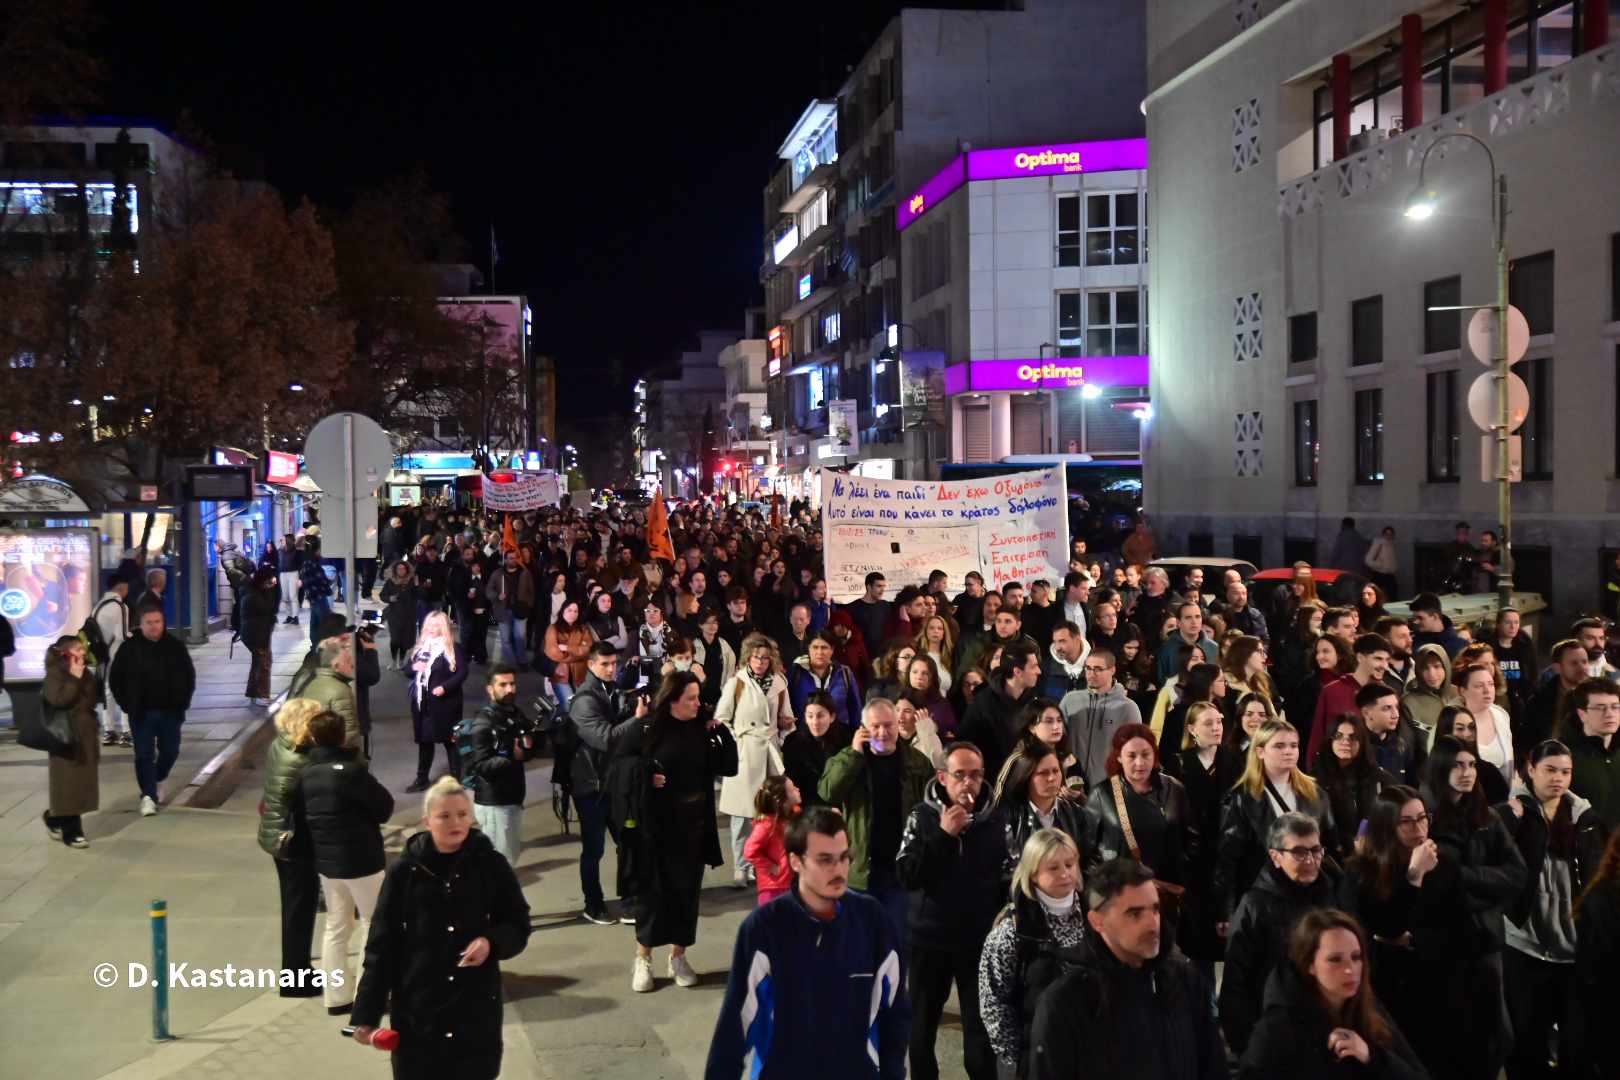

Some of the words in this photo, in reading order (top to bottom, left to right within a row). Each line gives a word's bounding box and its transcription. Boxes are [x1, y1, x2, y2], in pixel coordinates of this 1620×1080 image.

[1015, 150, 1080, 170] Optima
[1063, 162, 1082, 172] bank
[1017, 363, 1083, 383] Optima
[1067, 376, 1084, 386] bank
[873, 482, 891, 498] ένα
[896, 484, 926, 500] παιδί
[851, 504, 875, 518] είναι
[879, 508, 898, 519] που
[904, 505, 936, 520] κάνει
[942, 509, 953, 518] το
